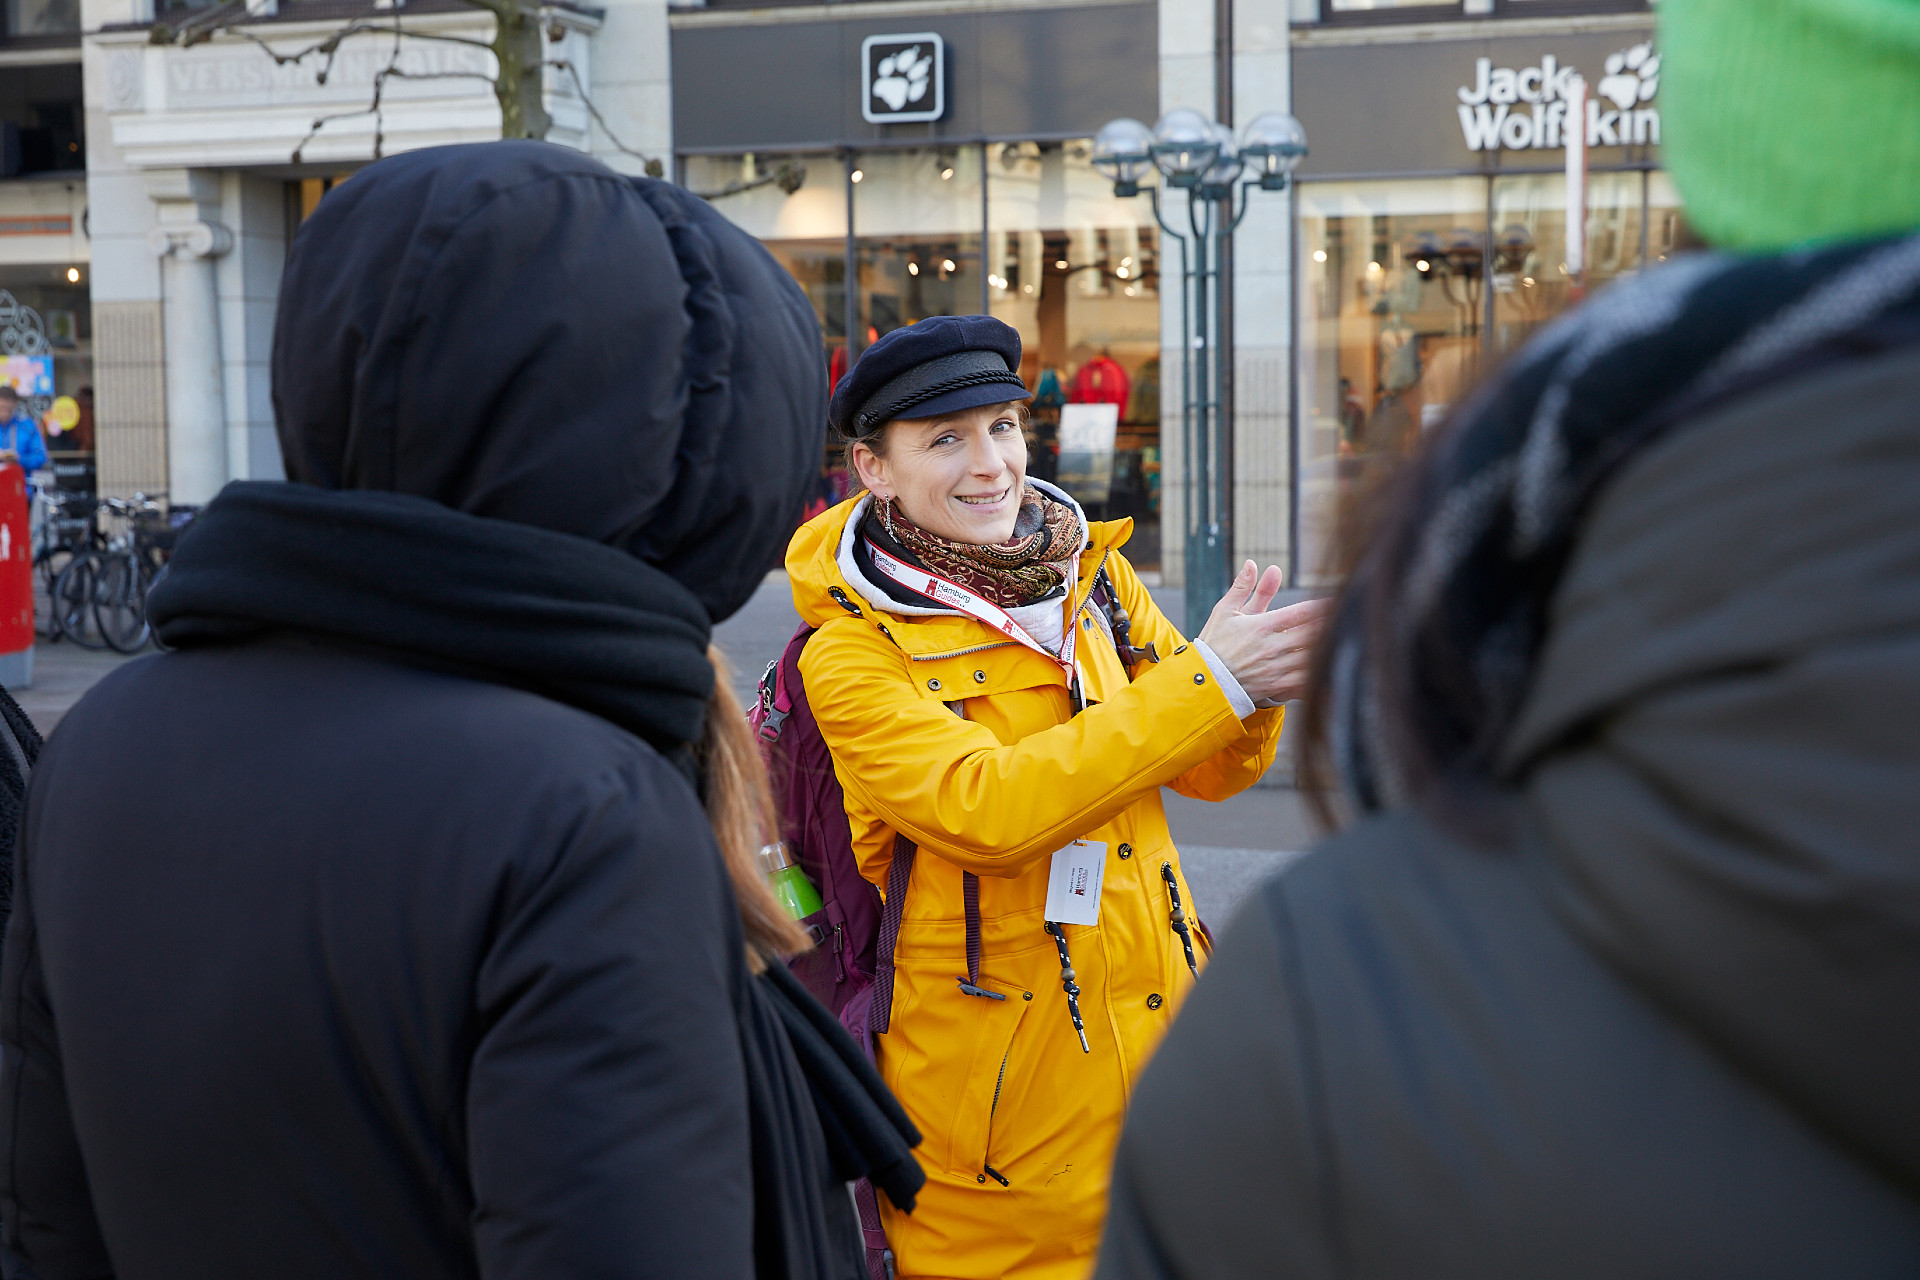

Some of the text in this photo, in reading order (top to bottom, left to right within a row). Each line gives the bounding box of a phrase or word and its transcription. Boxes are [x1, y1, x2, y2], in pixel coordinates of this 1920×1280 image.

[1457, 54, 1576, 104] Jack
[1457, 99, 1661, 151] Wolfkin
[937, 583, 971, 603] Hamburg
